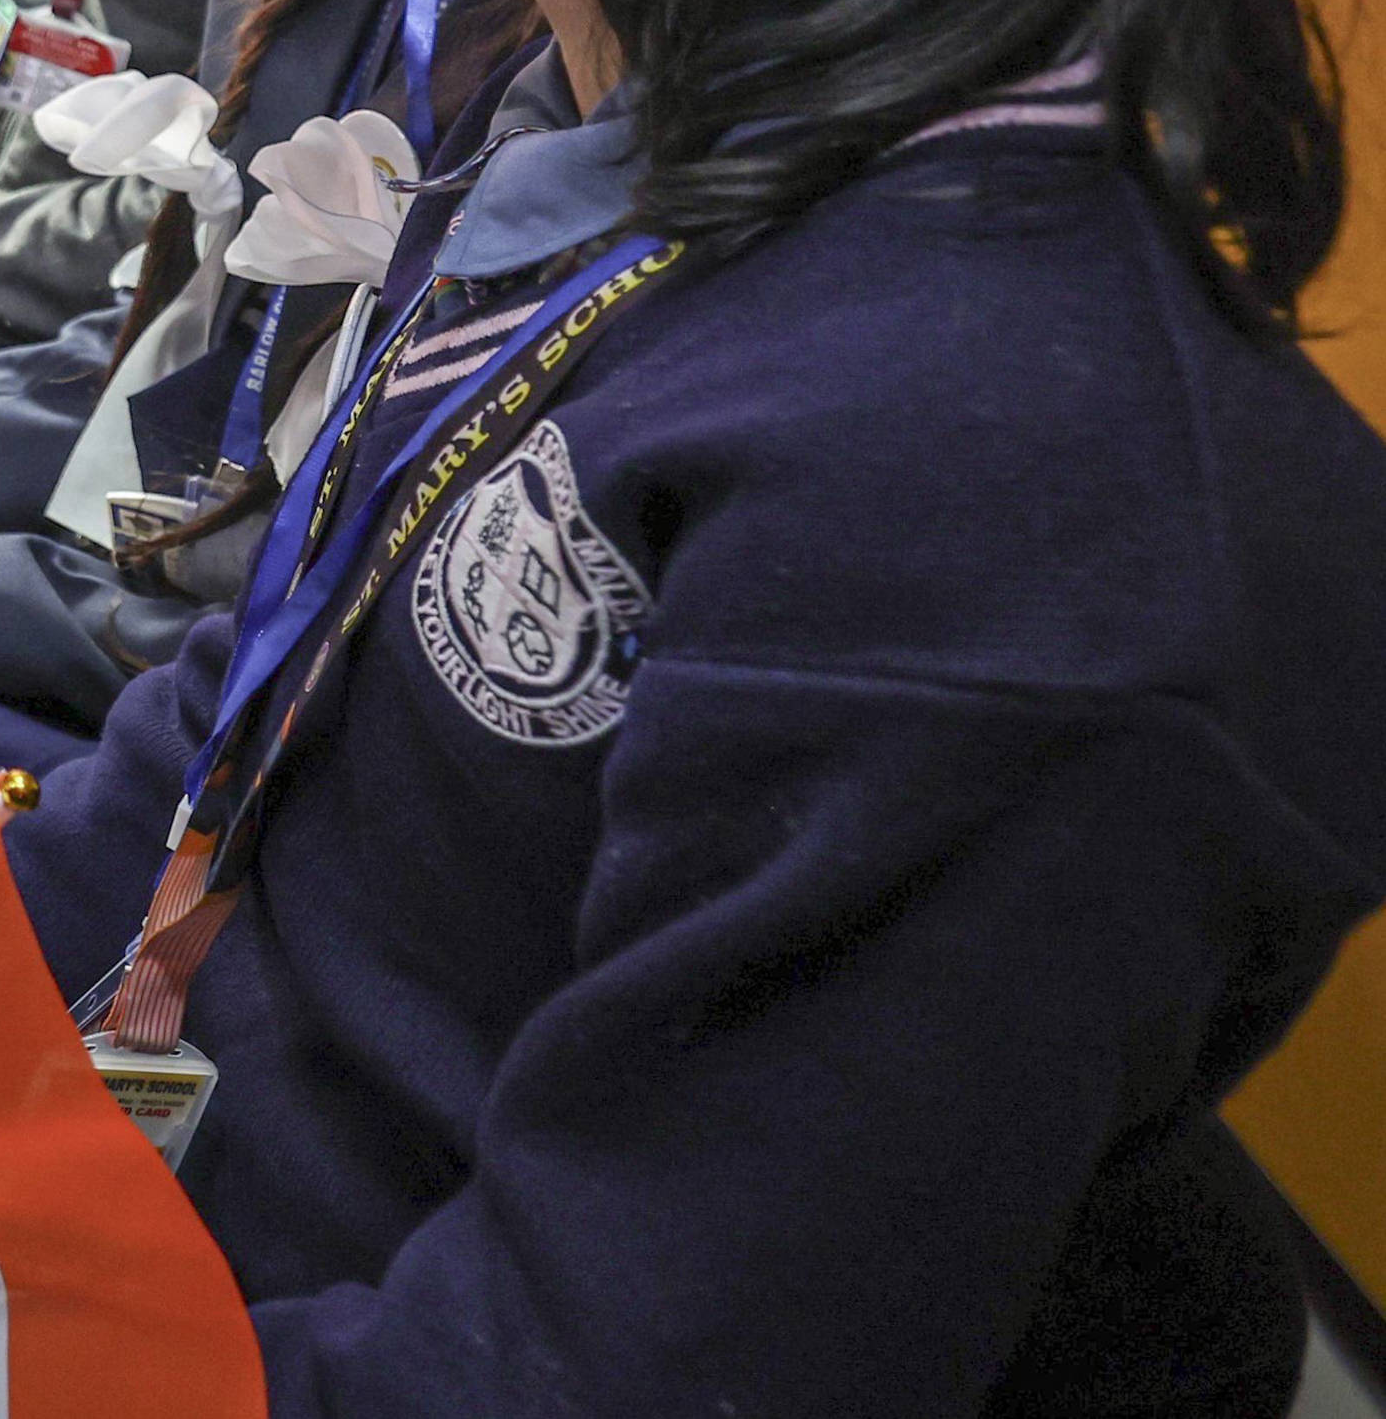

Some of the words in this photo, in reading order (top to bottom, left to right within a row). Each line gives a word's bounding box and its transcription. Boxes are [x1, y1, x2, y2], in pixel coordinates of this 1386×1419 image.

[246, 316, 279, 393] BARLOW
[386, 373, 532, 559] MARY'S
[416, 596, 469, 687] YOUR
[542, 674, 631, 737] SHINE
[135, 1106, 172, 1118] CARD
[147, 1080, 197, 1096] SCHOOL
